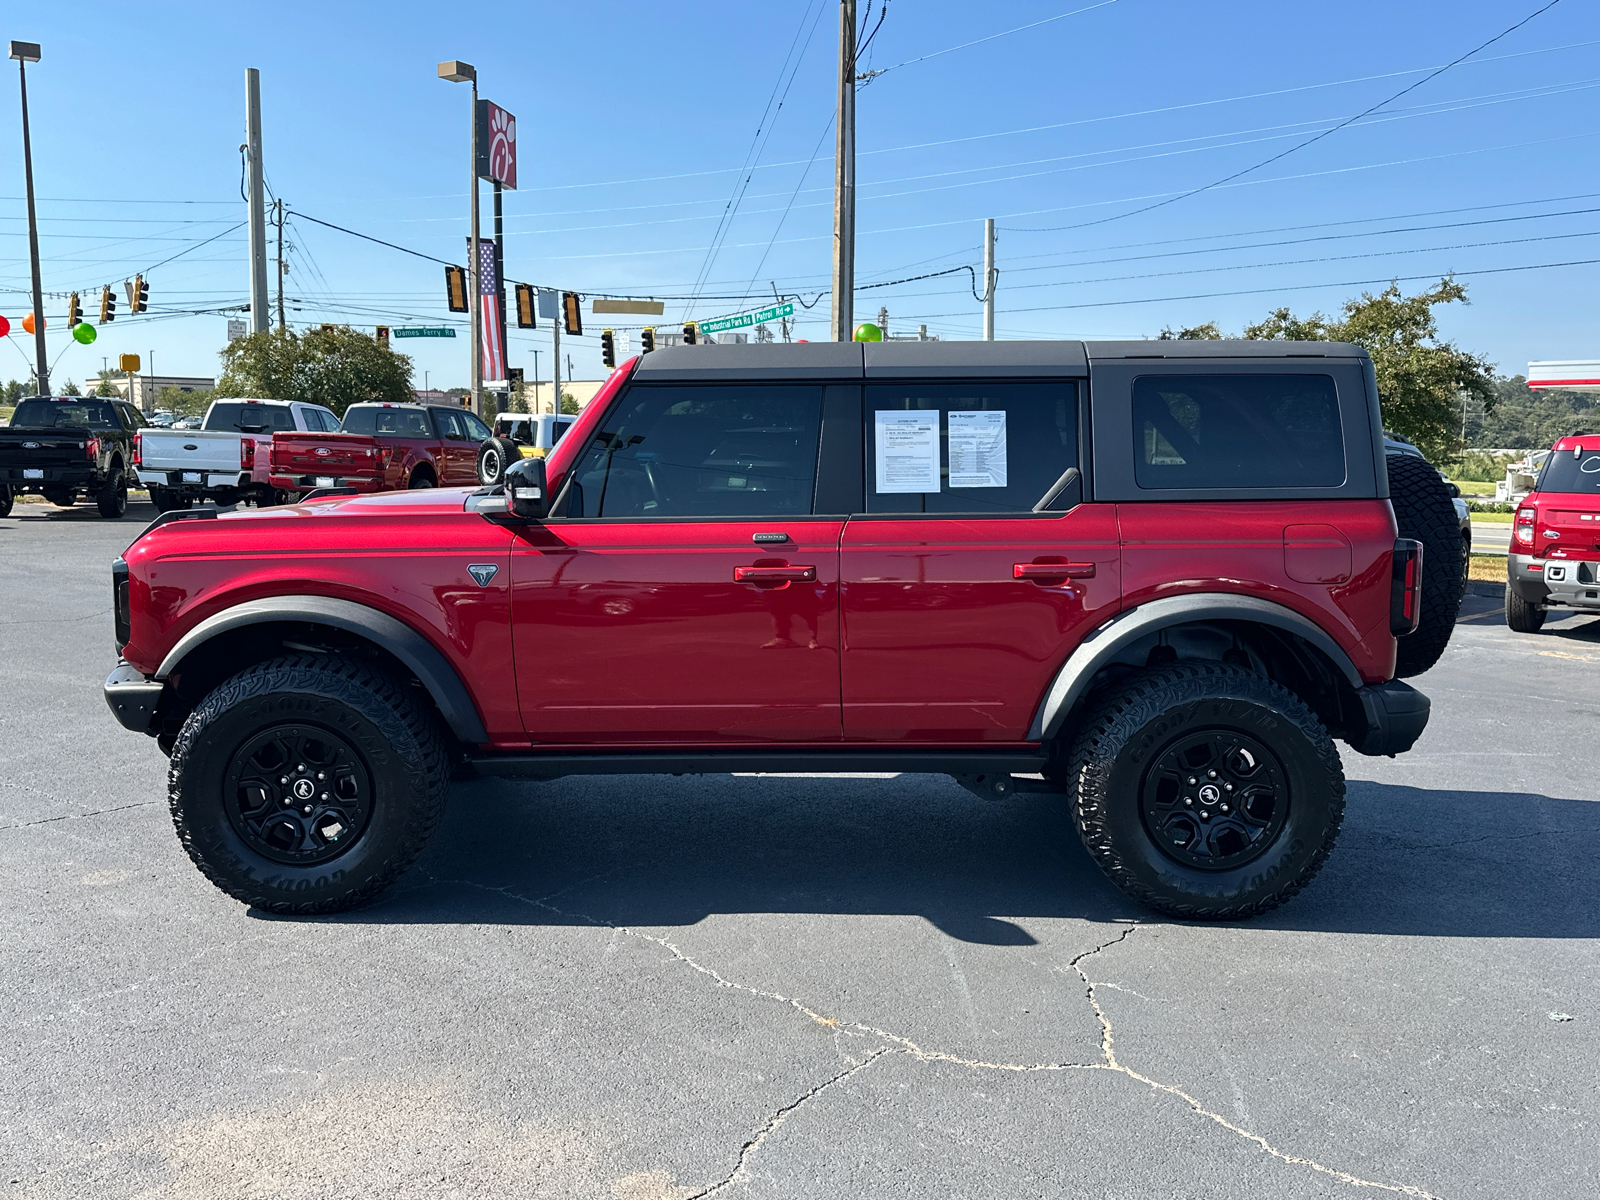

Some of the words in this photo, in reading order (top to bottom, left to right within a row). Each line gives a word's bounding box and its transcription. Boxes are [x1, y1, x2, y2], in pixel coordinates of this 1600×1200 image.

[756, 311, 772, 321] Patrol
[776, 307, 783, 316] Rd
[709, 319, 730, 331] Industrial
[731, 318, 742, 327] Park
[743, 316, 750, 324] Rd
[423, 329, 440, 337] Ferry
[292, 456, 354, 464] F-150
